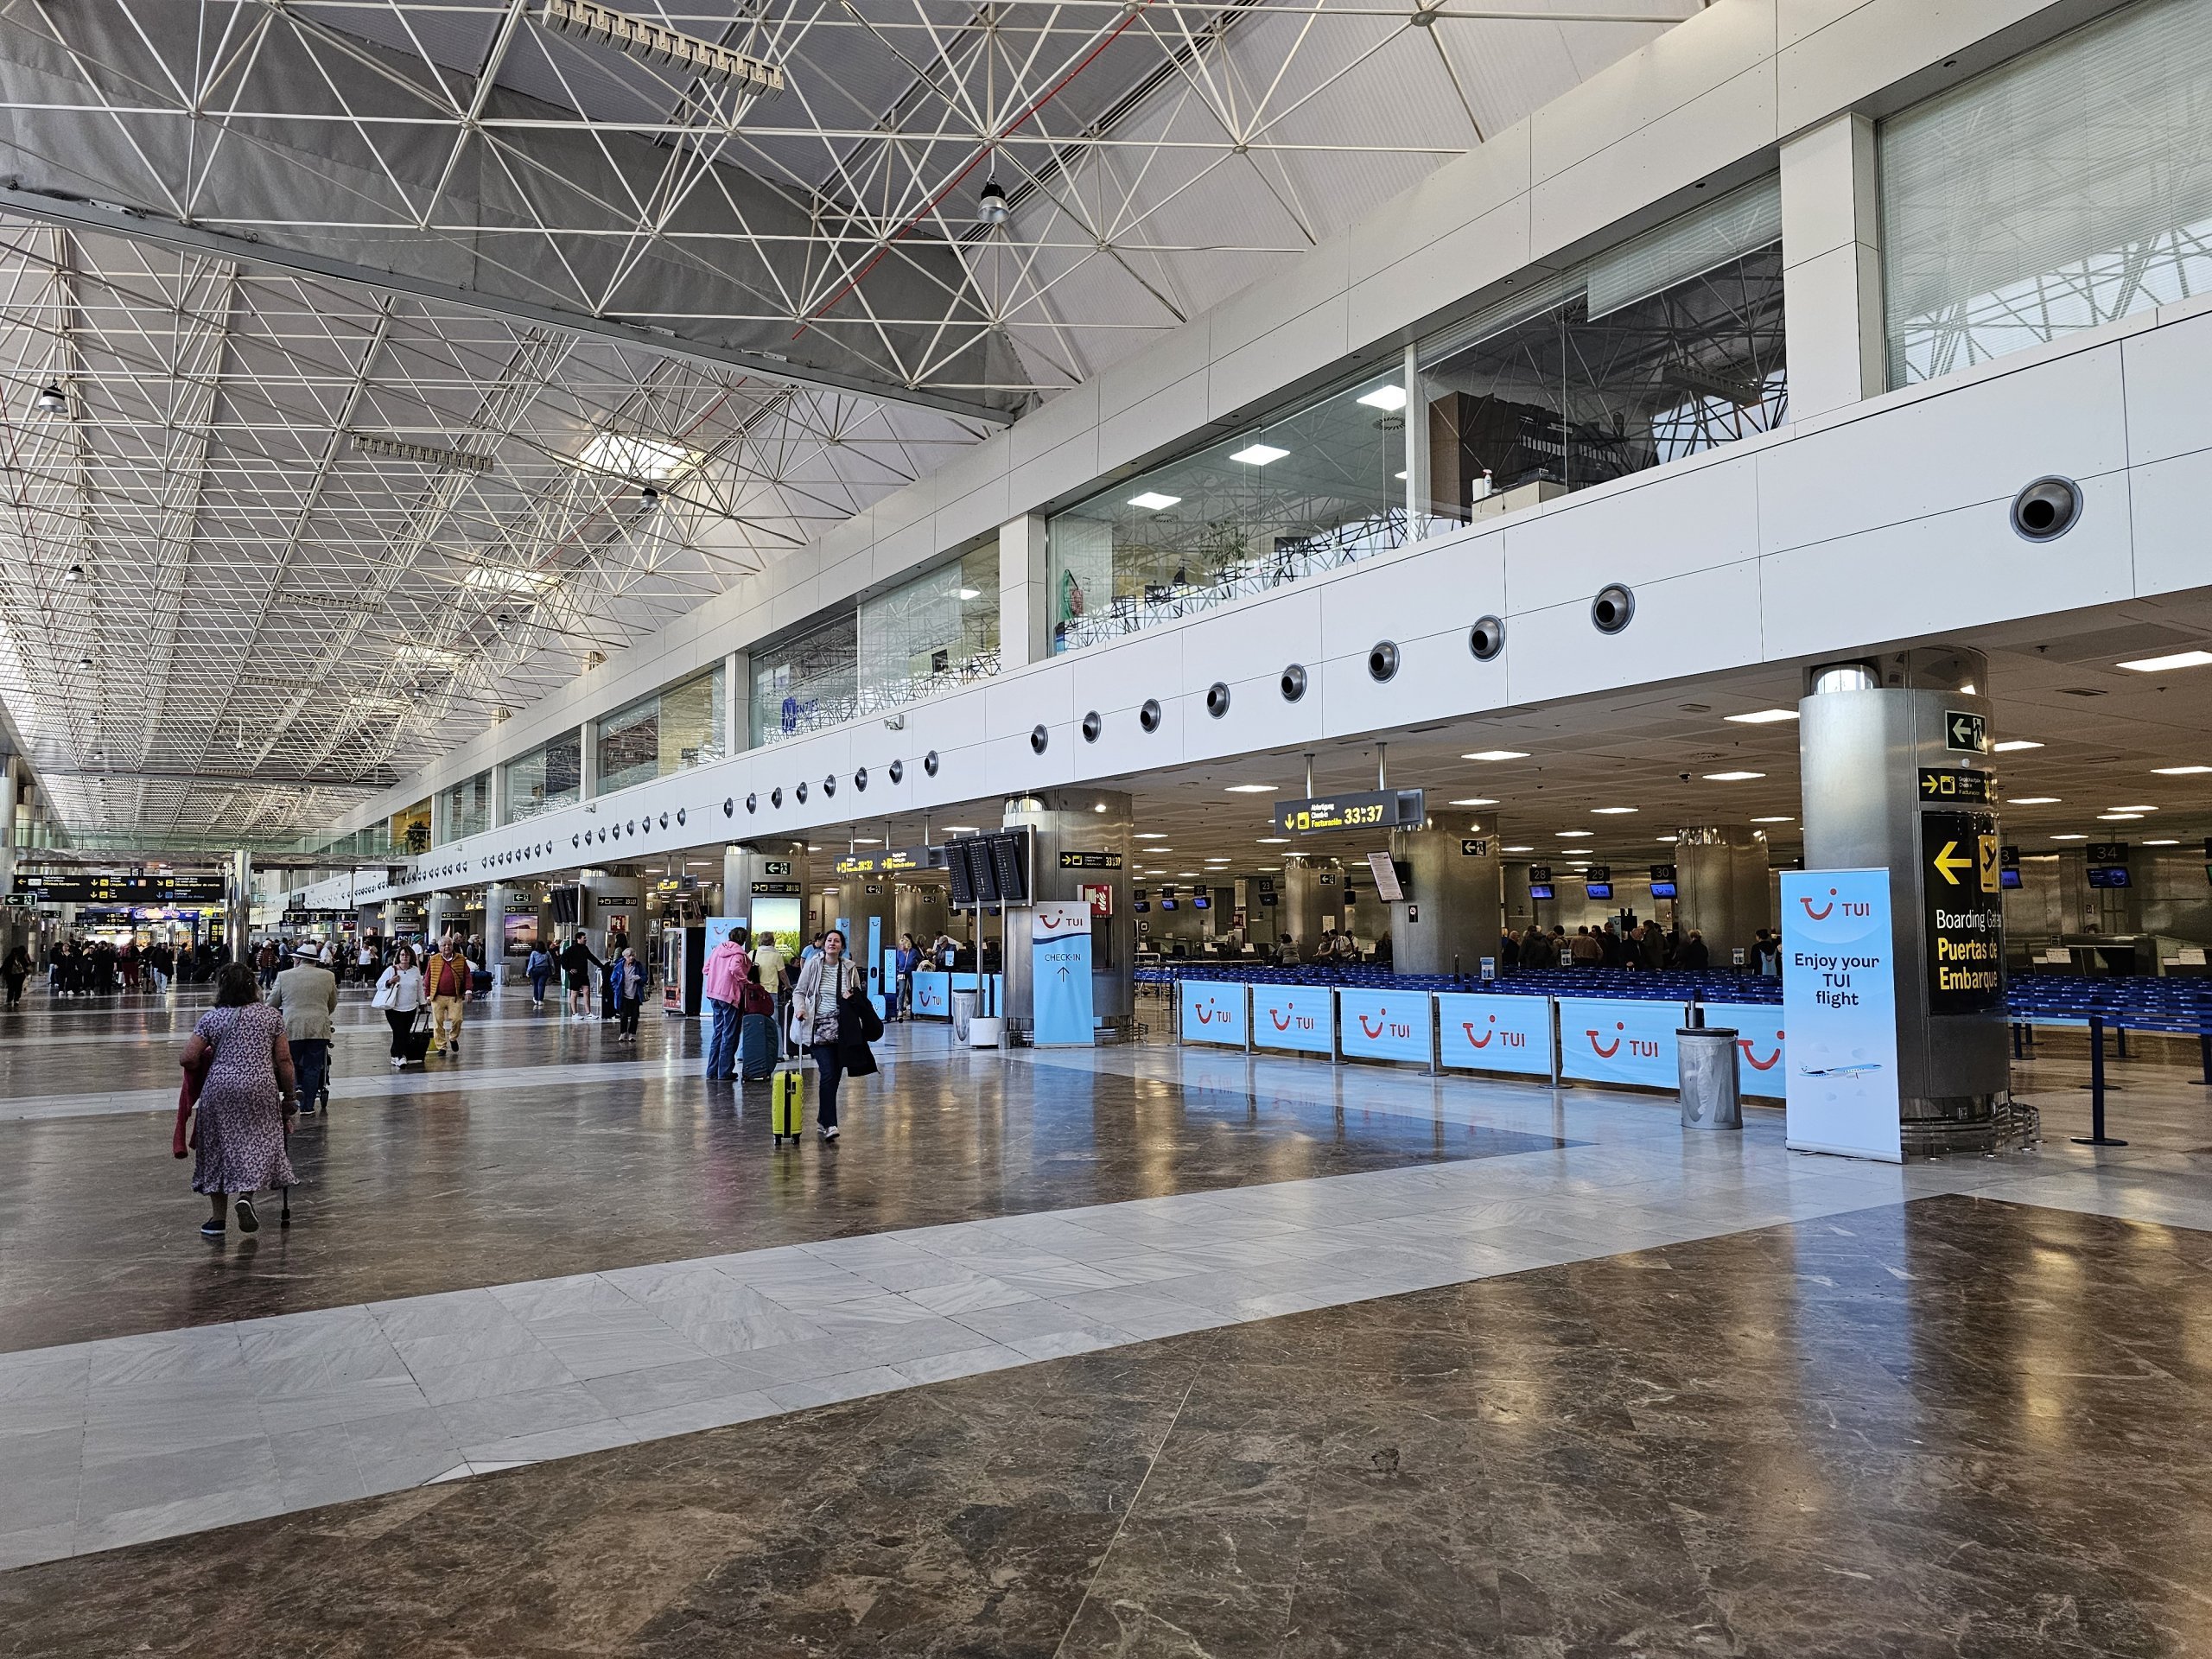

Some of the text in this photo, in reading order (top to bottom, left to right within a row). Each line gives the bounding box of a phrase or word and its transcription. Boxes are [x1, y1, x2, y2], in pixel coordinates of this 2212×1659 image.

[2001, 849, 2010, 862] 3
[2096, 846, 2119, 860] 34
[1534, 869, 1547, 880] 28
[1592, 869, 1605, 880] 29
[1656, 867, 1669, 878] 30
[1262, 881, 1270, 890] 23
[1841, 903, 1870, 917] TUI
[1065, 918, 1083, 926] TUI
[1936, 909, 1986, 932] Boarding
[1937, 937, 1998, 961] Puertas de
[1044, 953, 1081, 962] CHECK-IN
[1795, 952, 1880, 971] Enjoy your
[1822, 973, 1851, 988] TUI
[1939, 966, 1998, 993] Embarque
[932, 995, 942, 1006] TUI
[1815, 990, 1859, 1008] flight
[1216, 1011, 1231, 1023] TUI
[1295, 1016, 1314, 1030] TUI
[1389, 1023, 1410, 1039] TUI
[1499, 1032, 1525, 1048] TUI
[1629, 1039, 1658, 1058] TUI
